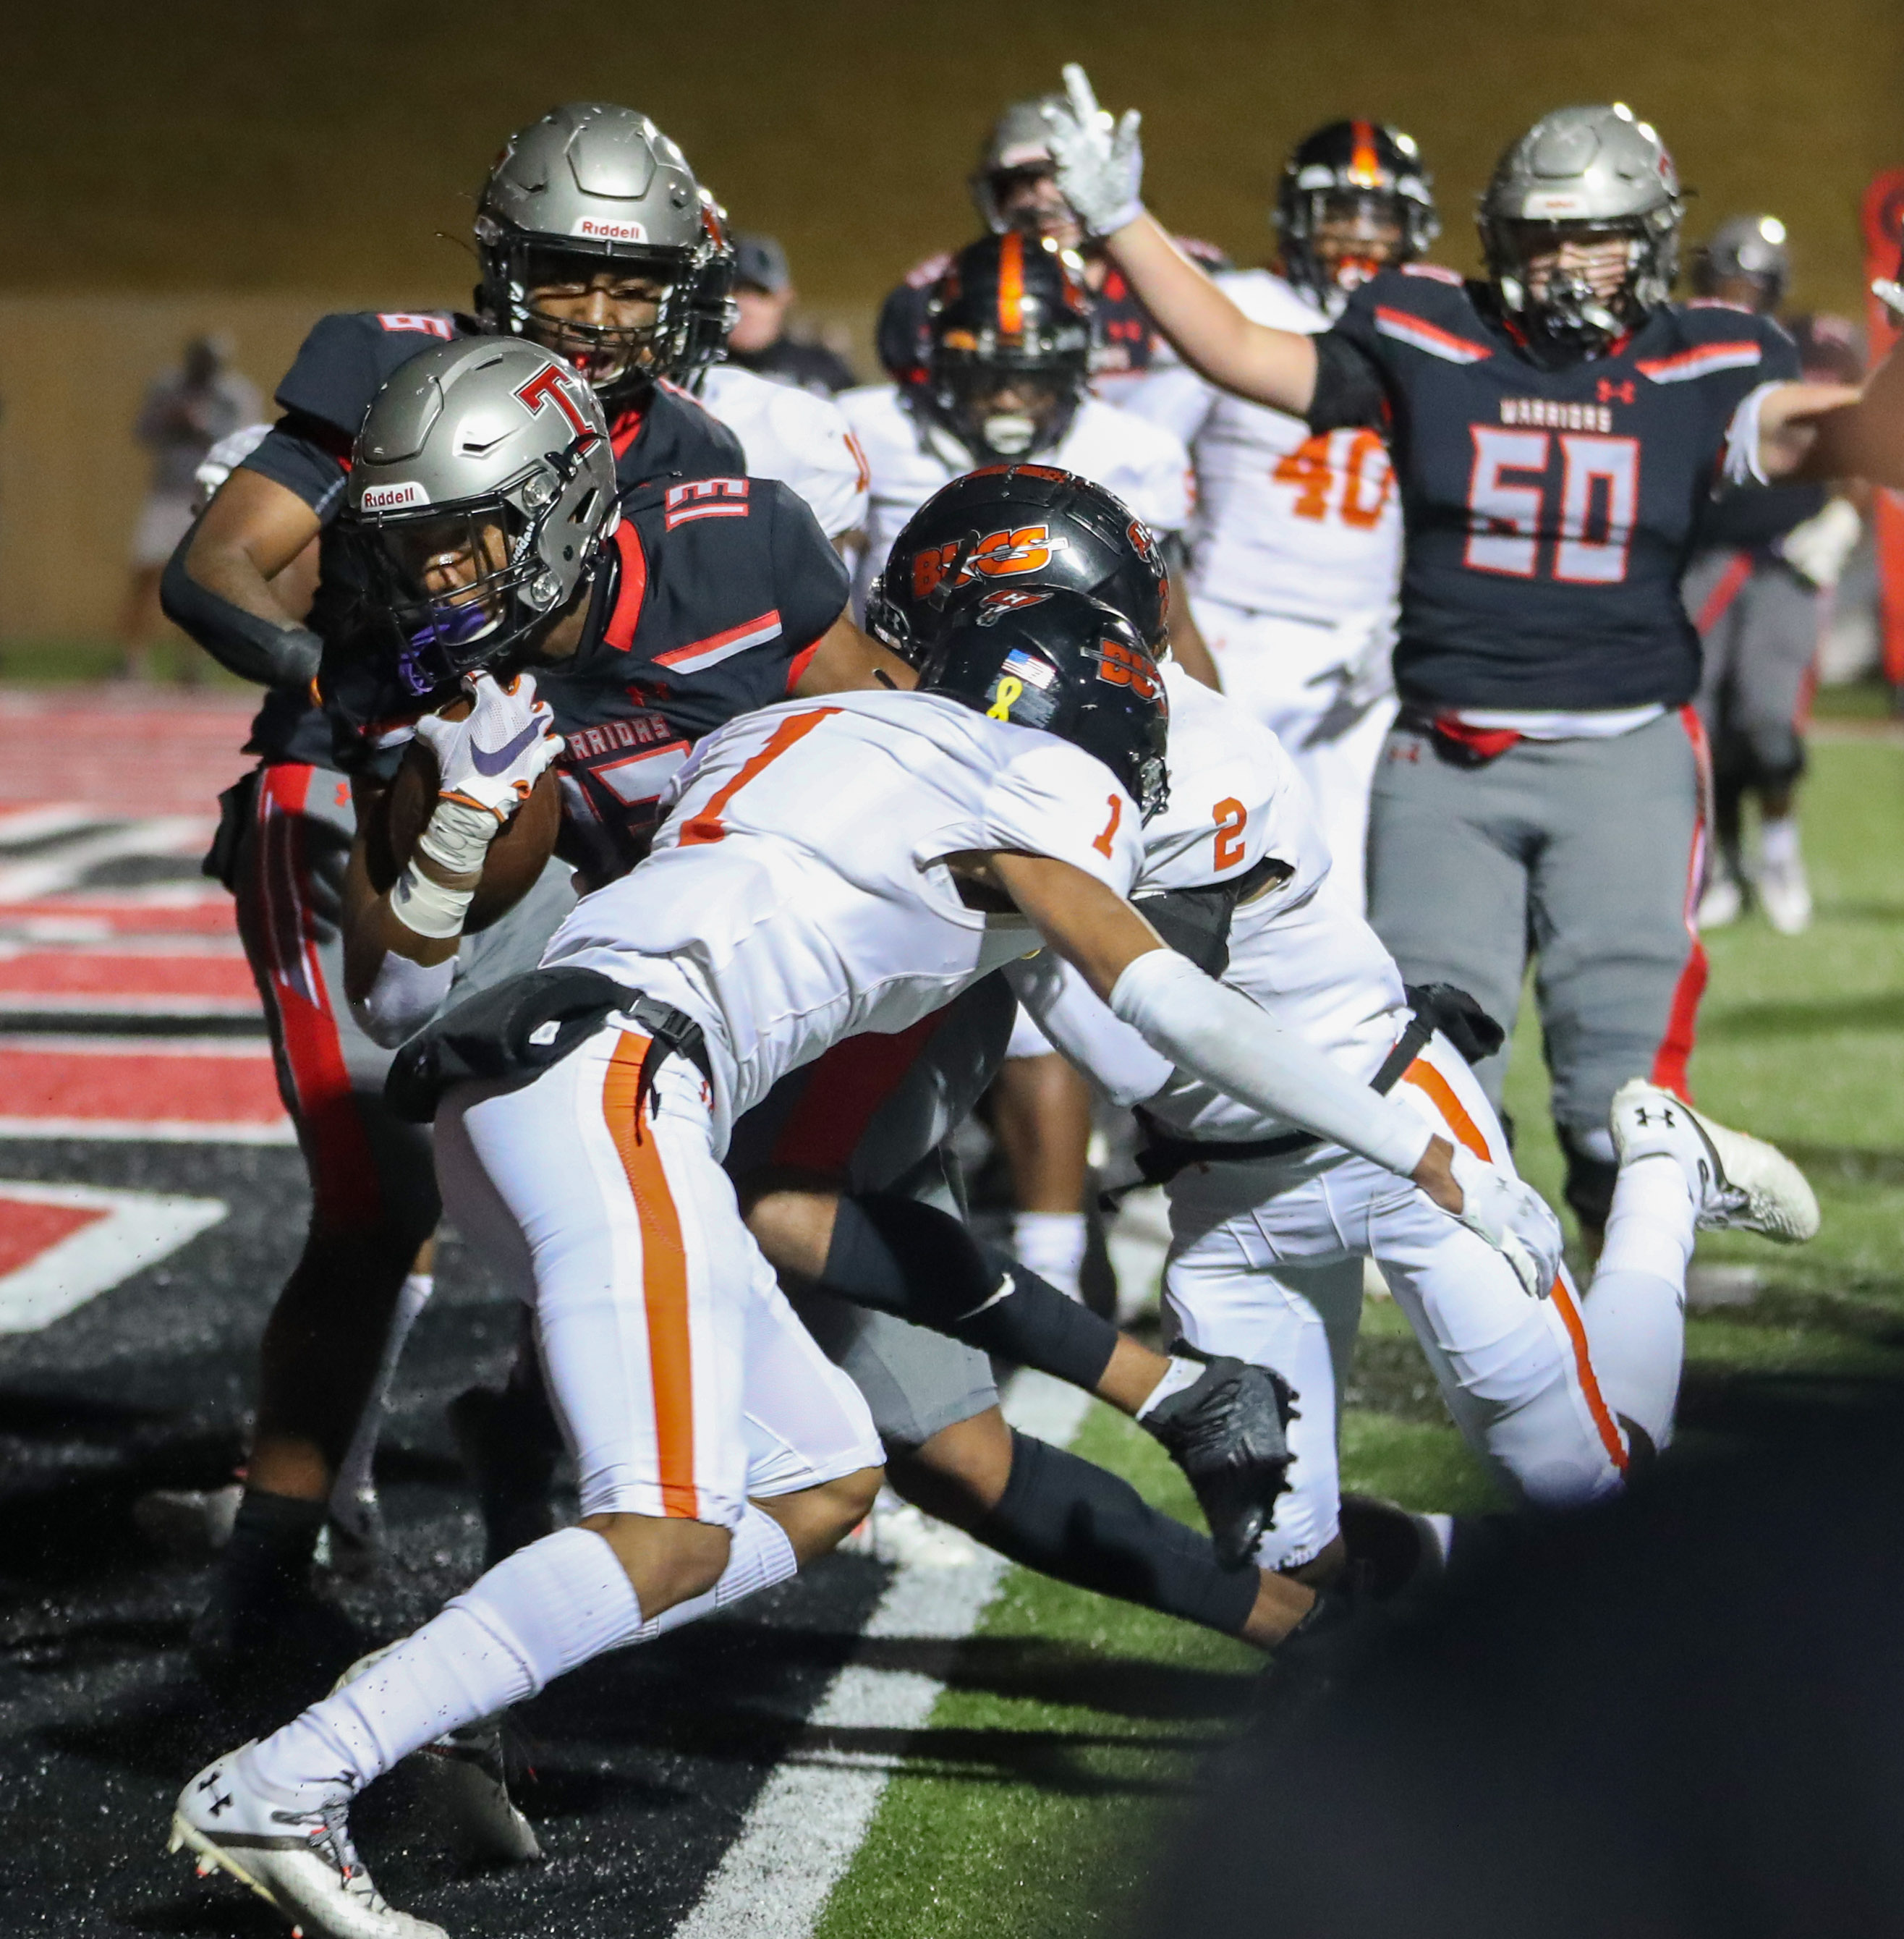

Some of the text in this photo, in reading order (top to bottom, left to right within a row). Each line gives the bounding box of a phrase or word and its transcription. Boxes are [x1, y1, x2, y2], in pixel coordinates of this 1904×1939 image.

[582, 221, 639, 239] Riddell
[509, 360, 601, 465] T
[365, 487, 415, 508] Riddell
[665, 477, 749, 533] 13
[1272, 425, 1398, 530] 40
[1462, 422, 1641, 587] 50
[1092, 793, 1123, 860] 1
[1212, 797, 1247, 873] 2
